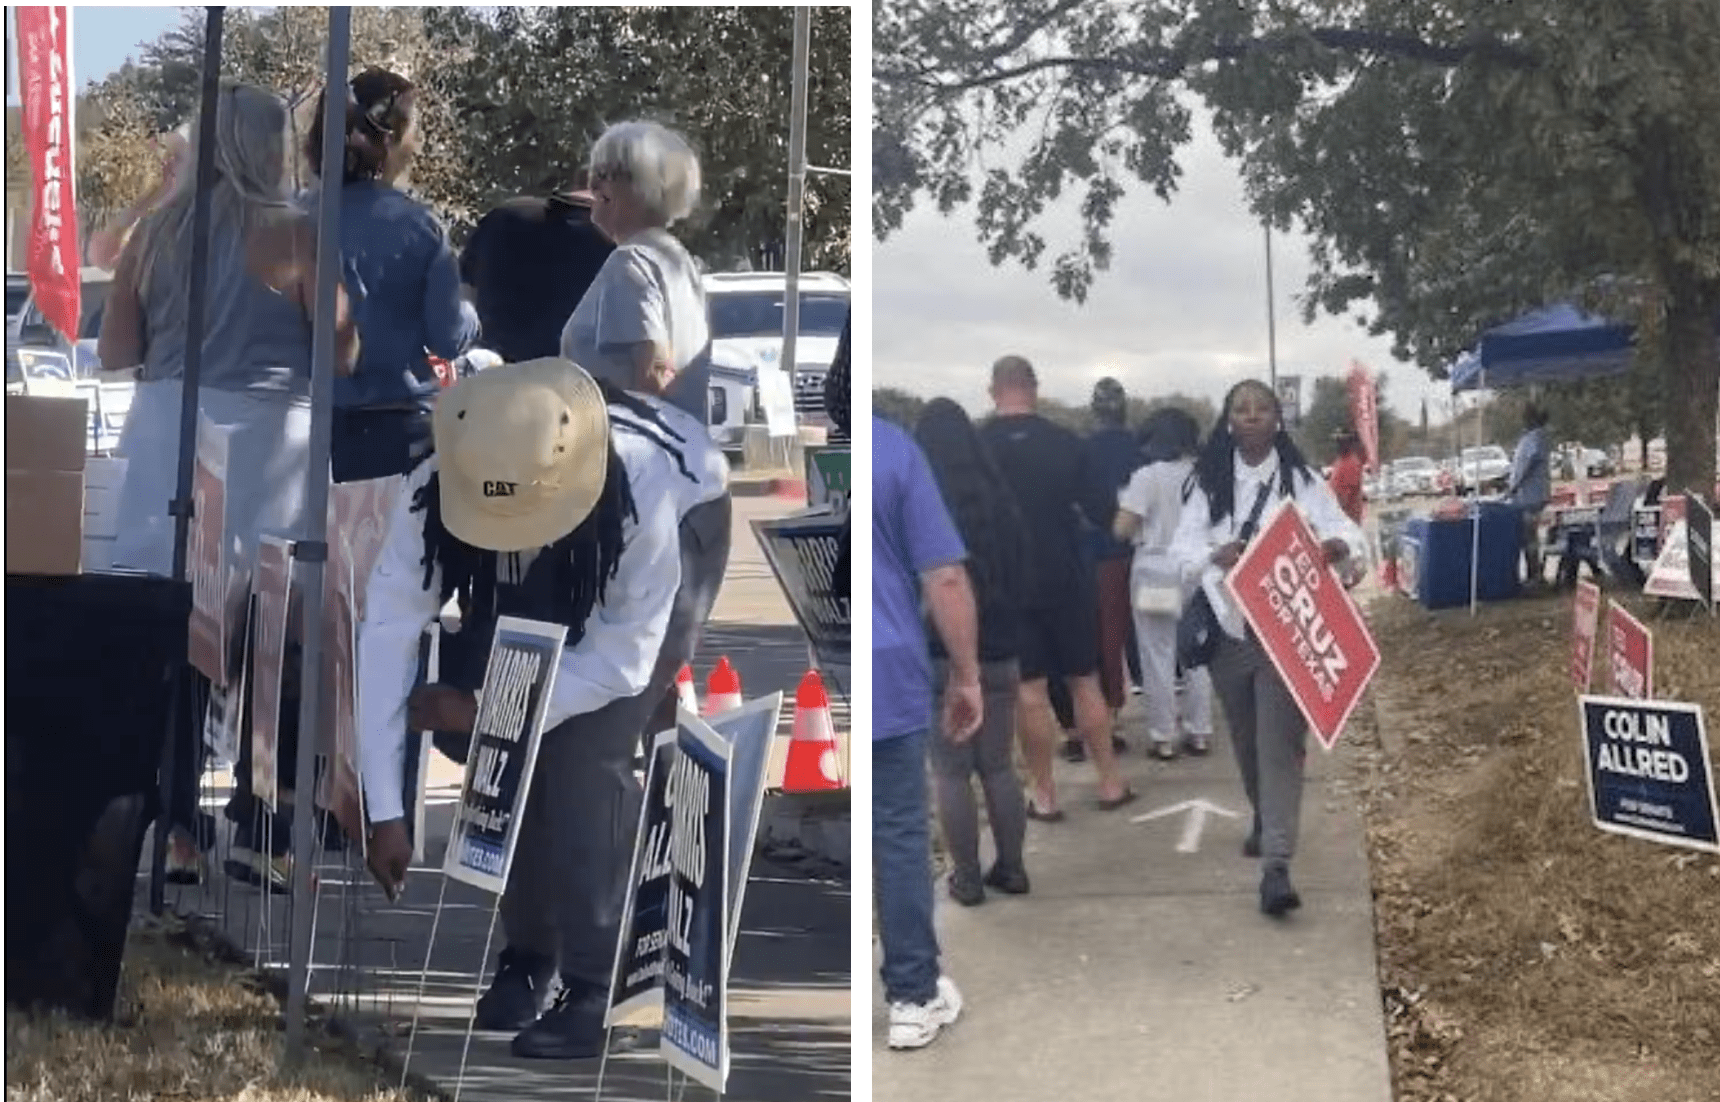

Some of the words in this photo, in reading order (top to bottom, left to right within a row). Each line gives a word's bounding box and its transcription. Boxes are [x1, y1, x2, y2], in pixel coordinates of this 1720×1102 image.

[483, 480, 520, 497] CAT
[1289, 531, 1320, 591] TED
[1259, 573, 1294, 625] FOR
[1274, 555, 1349, 684] CRUZ
[480, 647, 541, 743] HARRIS
[1604, 709, 1671, 747] COLIN
[1599, 742, 1689, 783] ALLRED
[638, 821, 673, 887] ALL
